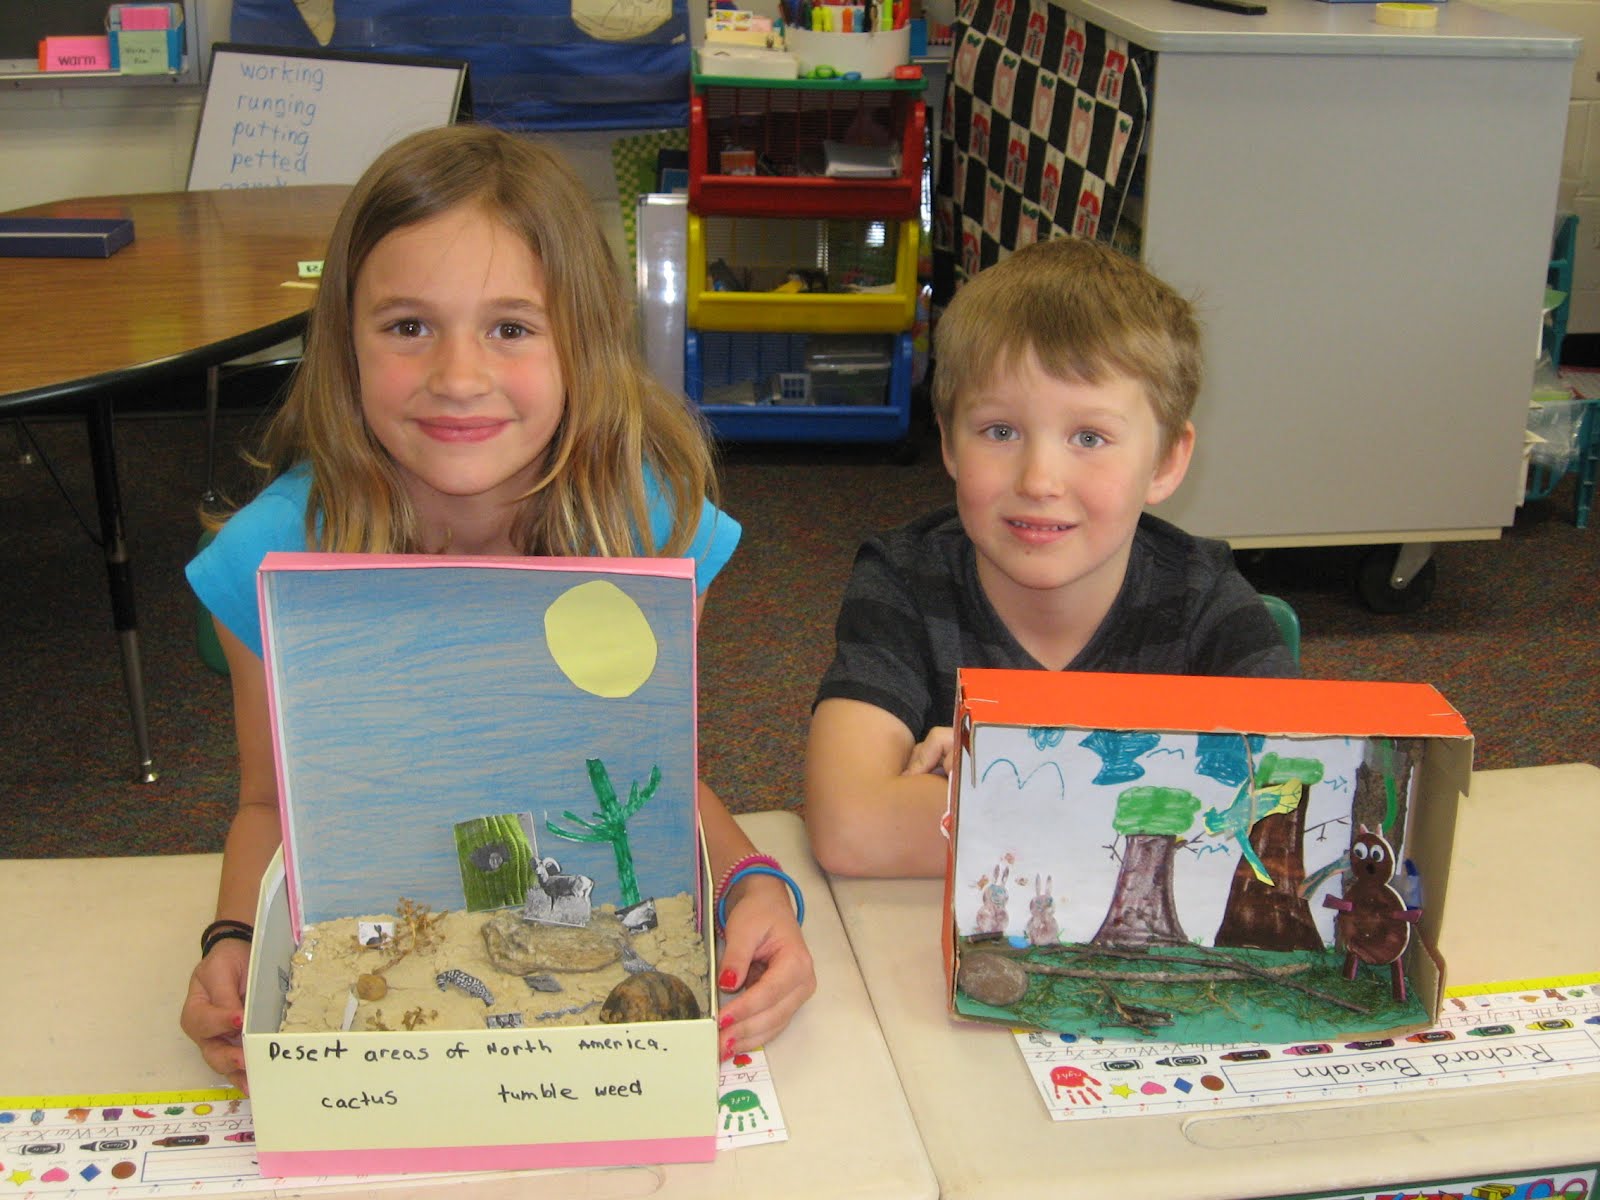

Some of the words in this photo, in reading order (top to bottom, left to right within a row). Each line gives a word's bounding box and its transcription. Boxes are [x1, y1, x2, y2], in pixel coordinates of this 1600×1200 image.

[58, 54, 97, 66] warm
[241, 61, 325, 92] working
[232, 119, 310, 156] putting
[230, 149, 308, 175] petted
[269, 1039, 348, 1061] Desert
[364, 1048, 429, 1061] areas
[446, 1042, 469, 1059] of
[486, 1039, 552, 1056] North
[1432, 1044, 1554, 1072] Richard
[1056, 1071, 1082, 1081] right
[1293, 1057, 1421, 1084] Busiahn
[737, 1072, 757, 1082] Aa
[498, 1083, 579, 1103] tumble
[594, 1080, 643, 1097] weed
[321, 1090, 398, 1109] cactus
[128, 1124, 155, 1136] Uu
[160, 1123, 181, 1134] Tt
[190, 1122, 211, 1132] Ss
[218, 1119, 243, 1130] Rr
[21, 1130, 50, 1141] Xx
[56, 1128, 91, 1140] Ww
[98, 1127, 119, 1138] Vv
